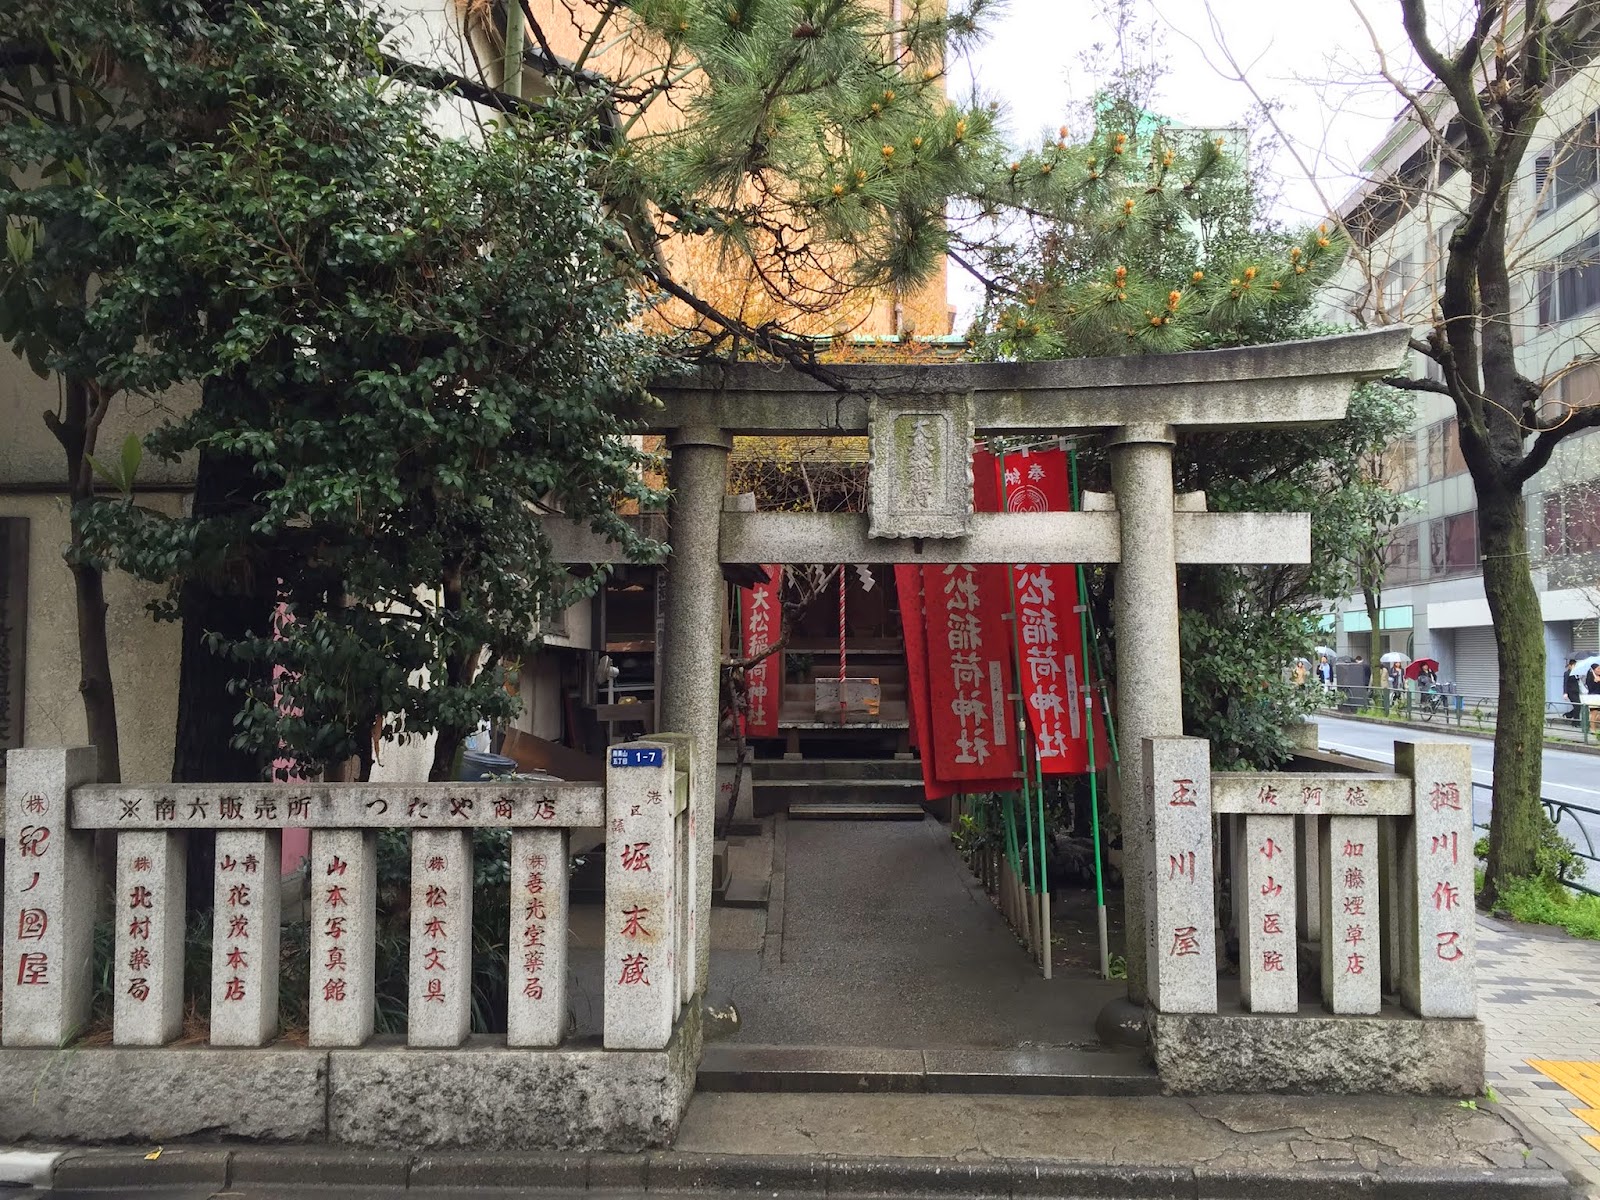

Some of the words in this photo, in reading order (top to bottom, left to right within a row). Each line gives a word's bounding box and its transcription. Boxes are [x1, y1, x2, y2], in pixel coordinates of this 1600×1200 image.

[747, 587, 771, 726] 大松稲荷神社
[365, 796, 557, 820] つたや商店
[636, 752, 656, 762] 1-7
[323, 855, 348, 1002] 山本写真館
[1169, 779, 1200, 957] 玉川屋
[1259, 837, 1284, 972] 小山医院
[1343, 839, 1365, 975] 加藤煙草店
